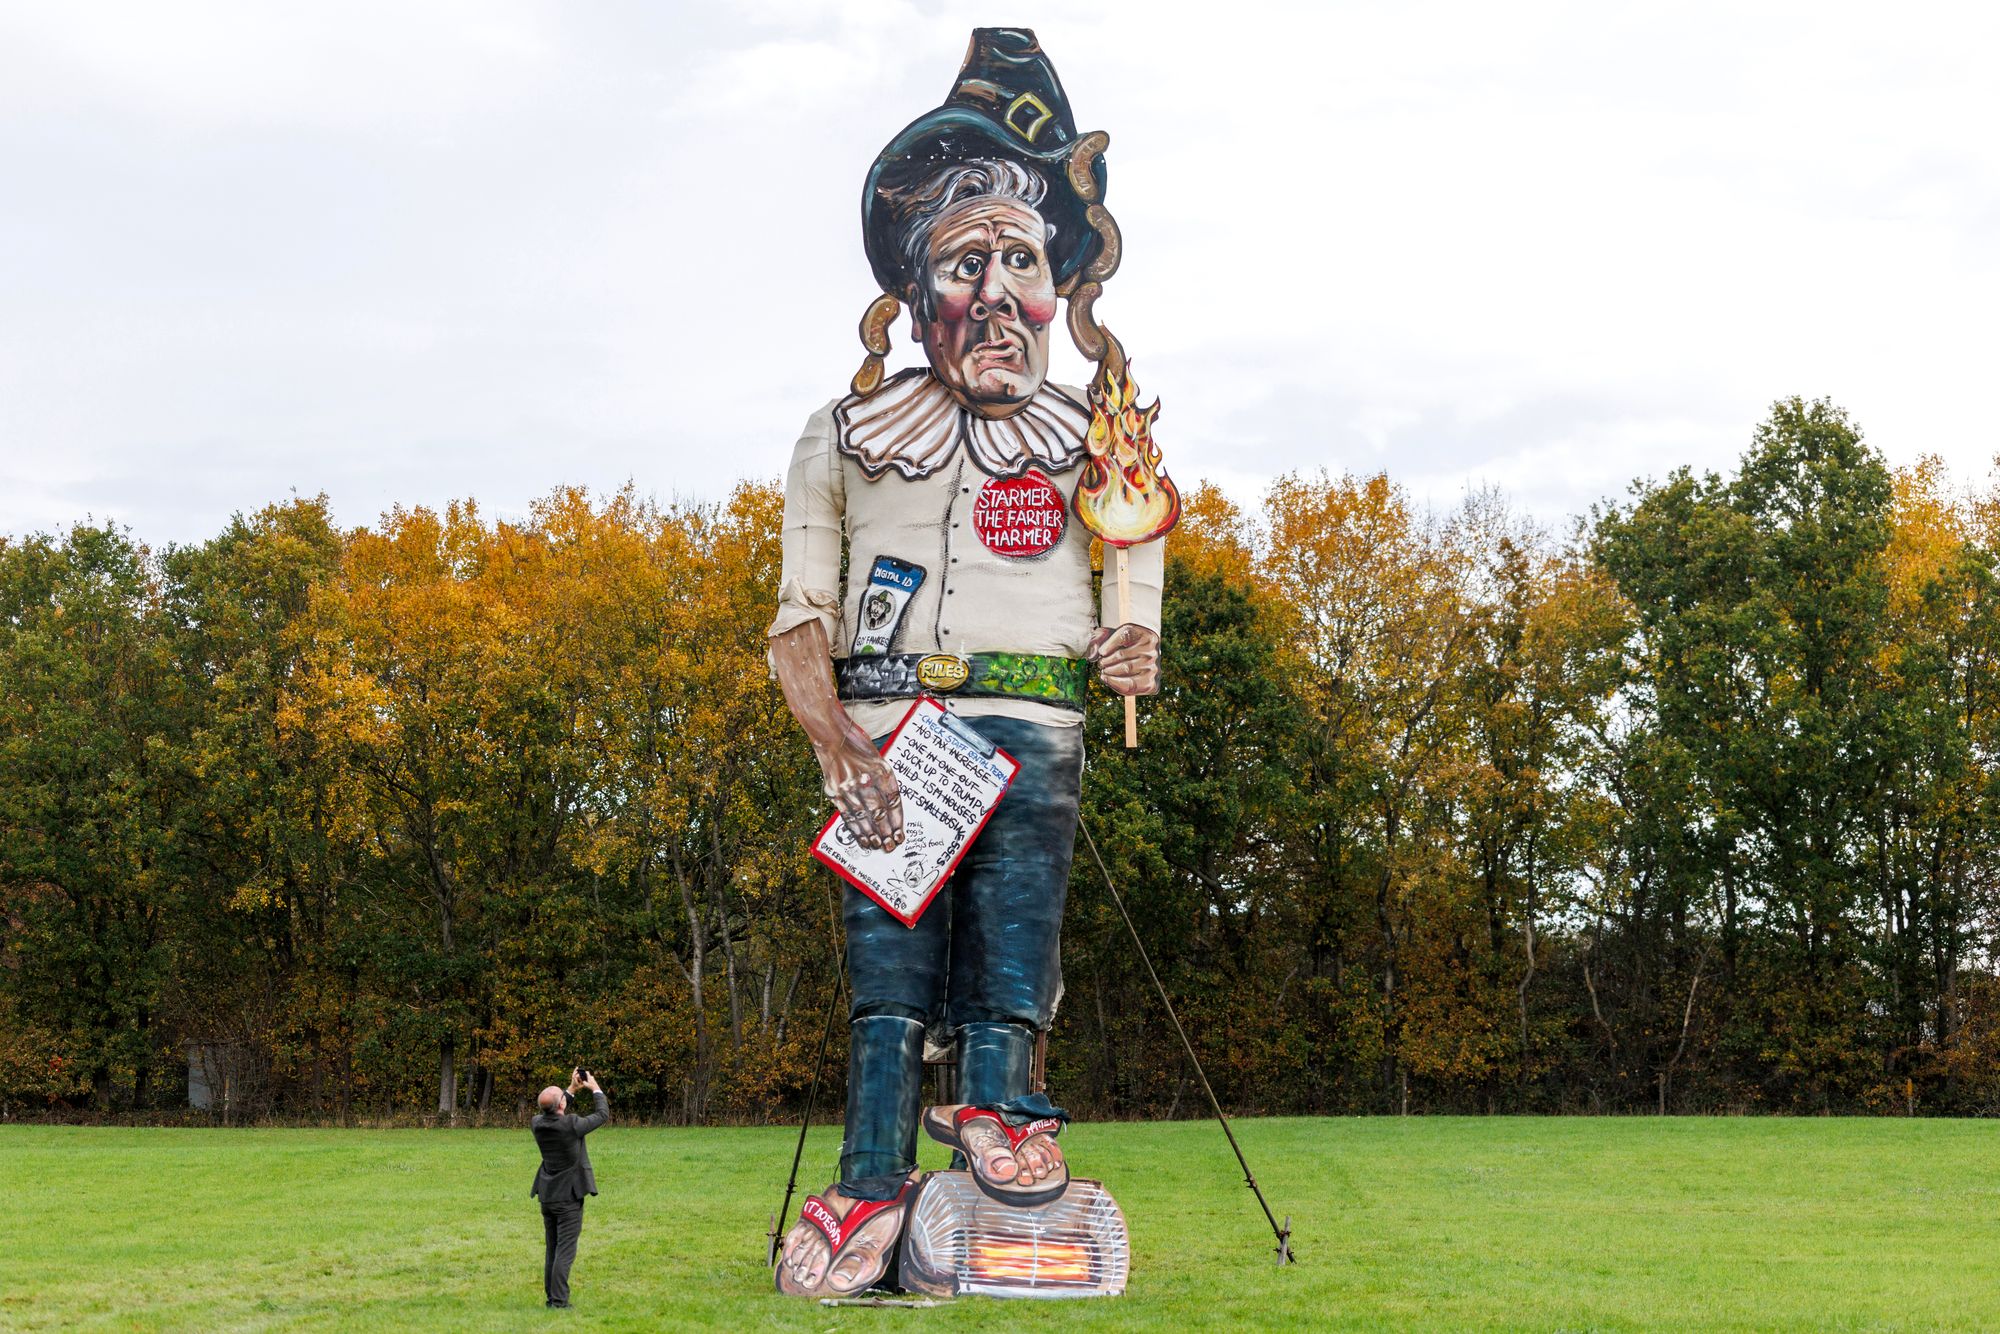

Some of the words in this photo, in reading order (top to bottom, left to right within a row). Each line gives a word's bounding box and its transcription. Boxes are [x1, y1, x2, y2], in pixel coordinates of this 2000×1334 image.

[978, 487, 1054, 509] STARMER
[975, 510, 1004, 528] THE
[1007, 509, 1063, 529] FARMER
[985, 528, 1053, 547] HARMER
[874, 567, 900, 583] DIGITAL
[901, 576, 913, 587] ID
[921, 661, 966, 679] RULES
[921, 715, 945, 737] CHECK
[945, 735, 968, 752] STAFF
[908, 738, 927, 755] ONE
[926, 752, 938, 762] IN
[940, 761, 957, 777] ONE
[959, 775, 980, 791] OUT
[916, 725, 932, 739] NO
[933, 734, 948, 752] TAX
[949, 748, 991, 784] INCREASE
[893, 760, 918, 781] BUILD
[942, 794, 977, 825] HOUSES
[901, 749, 924, 769] SUCK
[924, 764, 937, 777] UP
[939, 773, 949, 786] TO
[950, 782, 982, 809] TRUMP
[915, 795, 940, 819] SMALL
[847, 863, 857, 874] HIS
[880, 888, 895, 903] BACK
